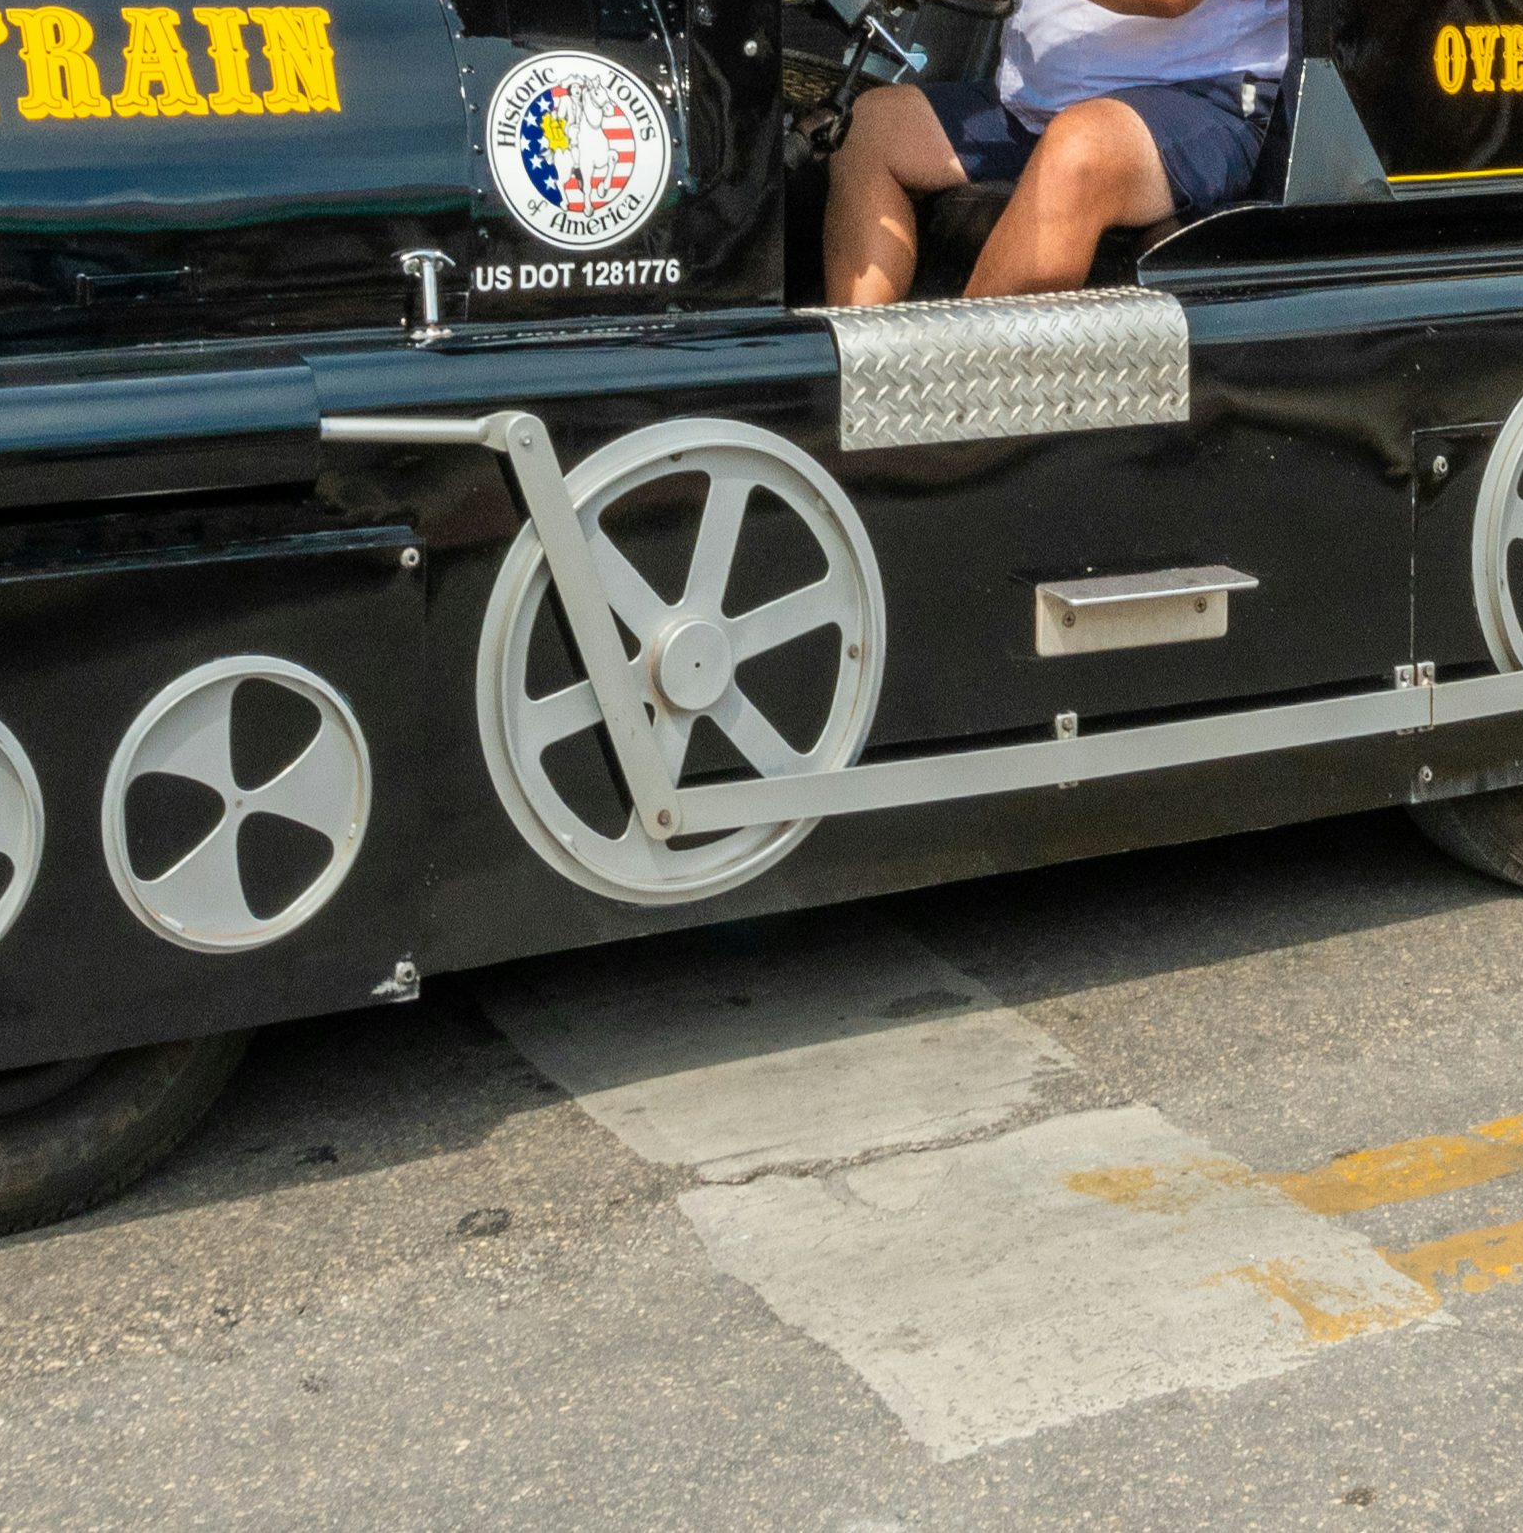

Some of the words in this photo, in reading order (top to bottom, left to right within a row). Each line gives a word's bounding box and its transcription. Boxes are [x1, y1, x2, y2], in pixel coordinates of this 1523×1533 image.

[496, 66, 559, 150] Historic
[607, 69, 657, 143] Tours
[527, 197, 550, 218] of
[476, 265, 513, 292] US
[519, 263, 576, 290] DOT
[581, 259, 681, 286] 1281776
